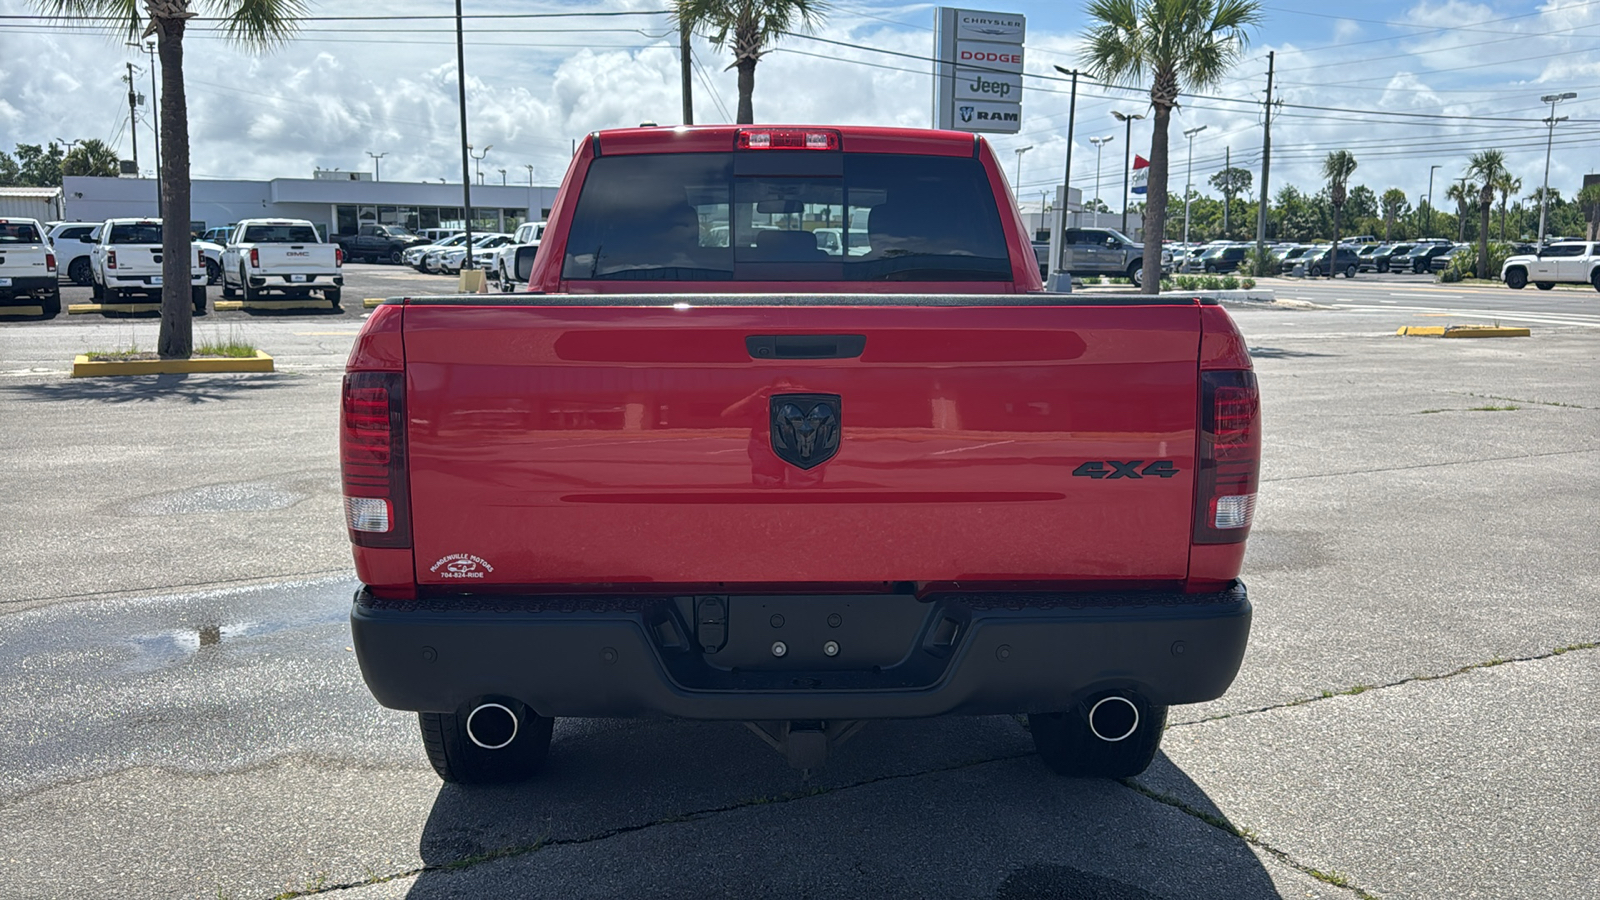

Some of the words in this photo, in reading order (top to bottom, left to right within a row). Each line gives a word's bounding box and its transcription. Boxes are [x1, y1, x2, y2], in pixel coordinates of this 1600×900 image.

[963, 17, 1021, 28] CHRYSLER
[961, 51, 1021, 64] DODGE
[970, 76, 1010, 97] Jeep
[977, 111, 1018, 122] RAM
[470, 554, 494, 573] MOTORS
